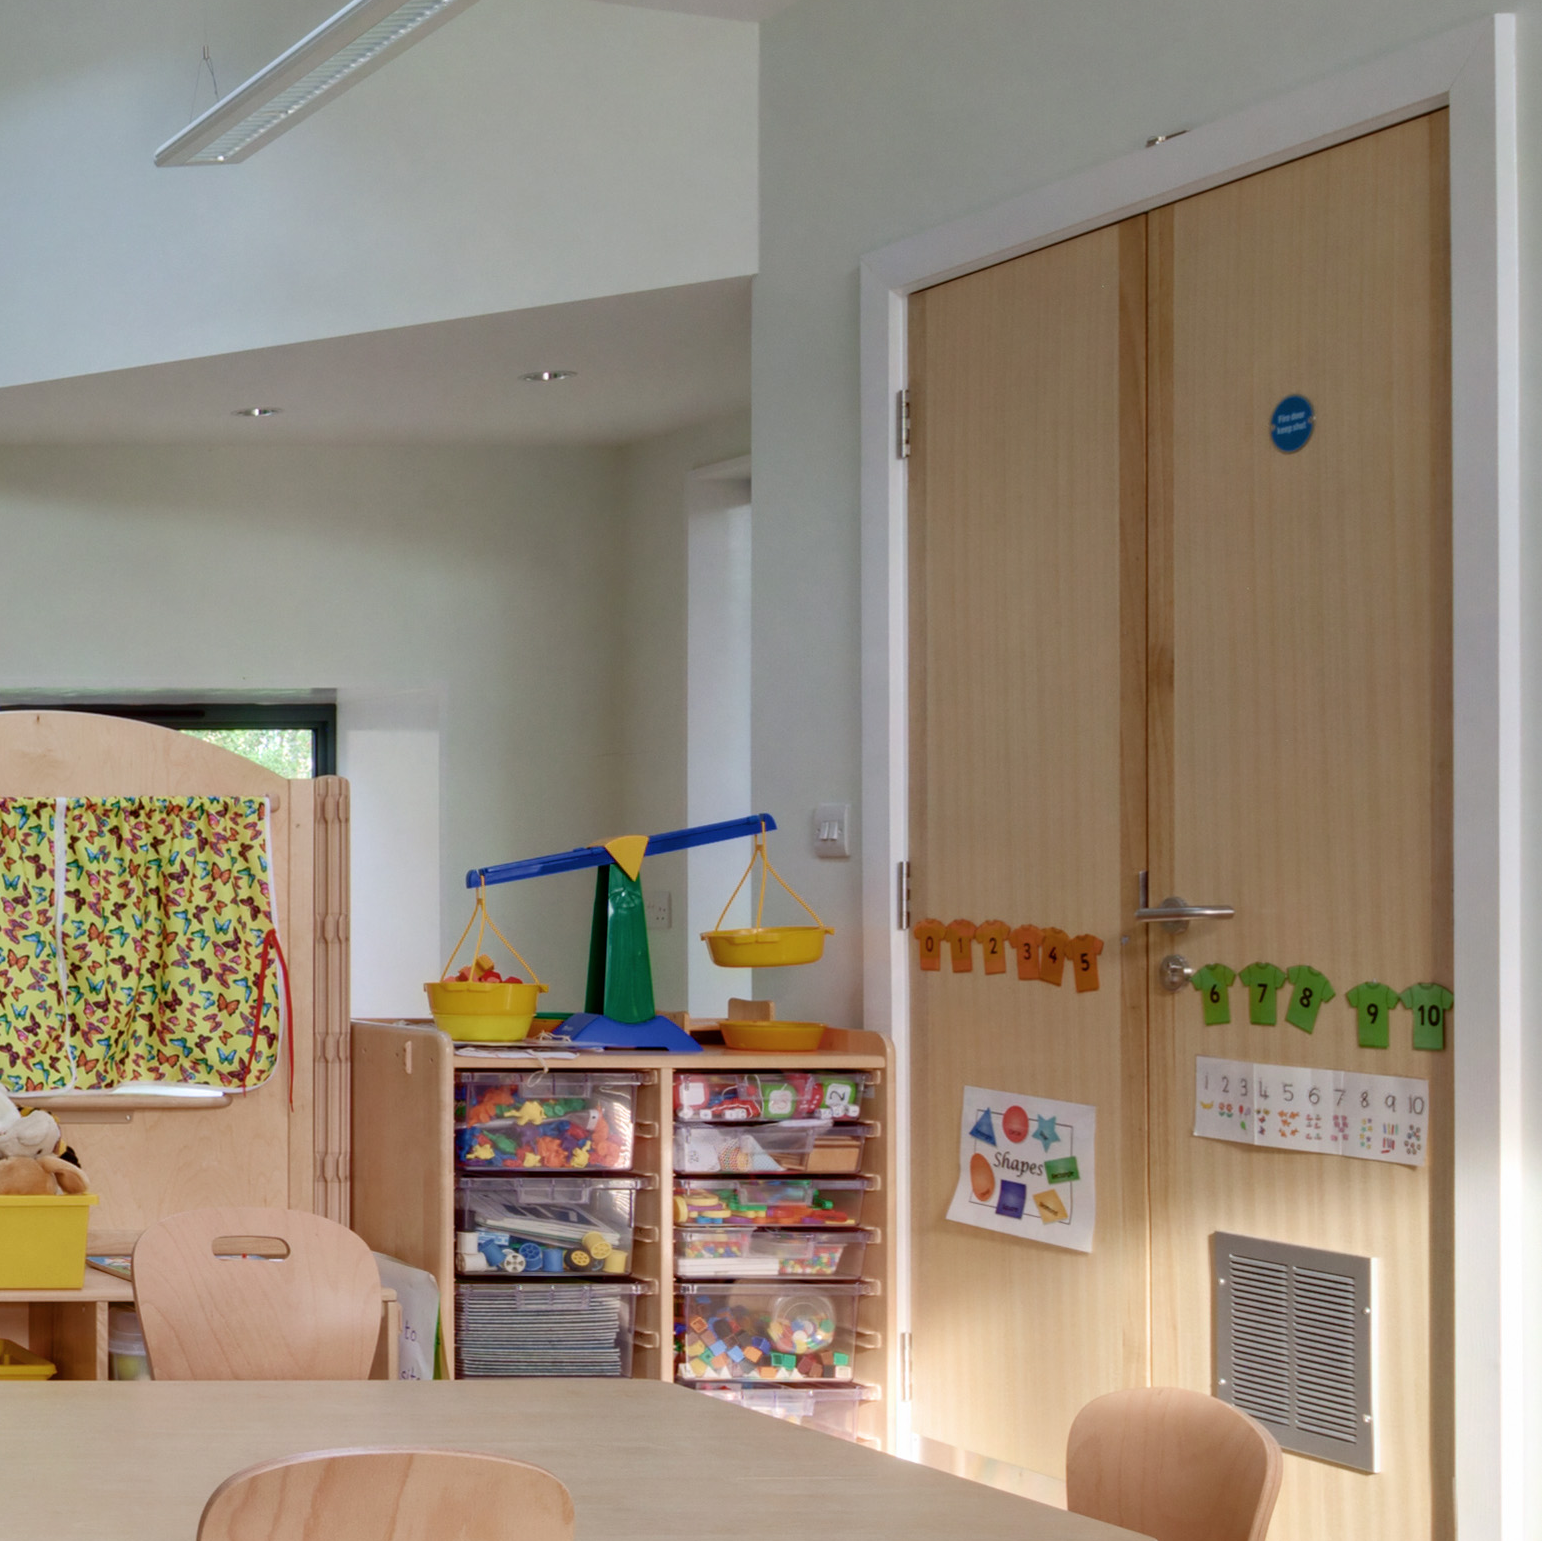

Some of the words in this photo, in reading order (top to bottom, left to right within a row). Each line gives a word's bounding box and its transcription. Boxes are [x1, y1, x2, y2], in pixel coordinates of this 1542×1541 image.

[926, 936, 934, 953] 0
[958, 938, 963, 953] 1
[989, 937, 997, 954] 2
[1024, 943, 1031, 960] 3
[1049, 947, 1057, 965] 4
[1080, 953, 1090, 971] 5
[1210, 984, 1220, 1004] 6
[1258, 984, 1267, 1003] 7
[1299, 987, 1313, 1008] 8
[1367, 1003, 1378, 1024] 9
[1417, 1005, 1440, 1027] 10
[1221, 1076, 1230, 1093] 2
[1240, 1078, 1248, 1097] 3
[1259, 1081, 1269, 1100] 4
[1282, 1083, 1294, 1102] 5
[1308, 1085, 1320, 1105] 6
[1333, 1089, 1346, 1107] 7
[1360, 1090, 1371, 1109] 8
[1384, 1095, 1396, 1113] 9
[1408, 1095, 1425, 1115] 10
[993, 1151, 1044, 1177] Shapes
[405, 1319, 417, 1343] to
